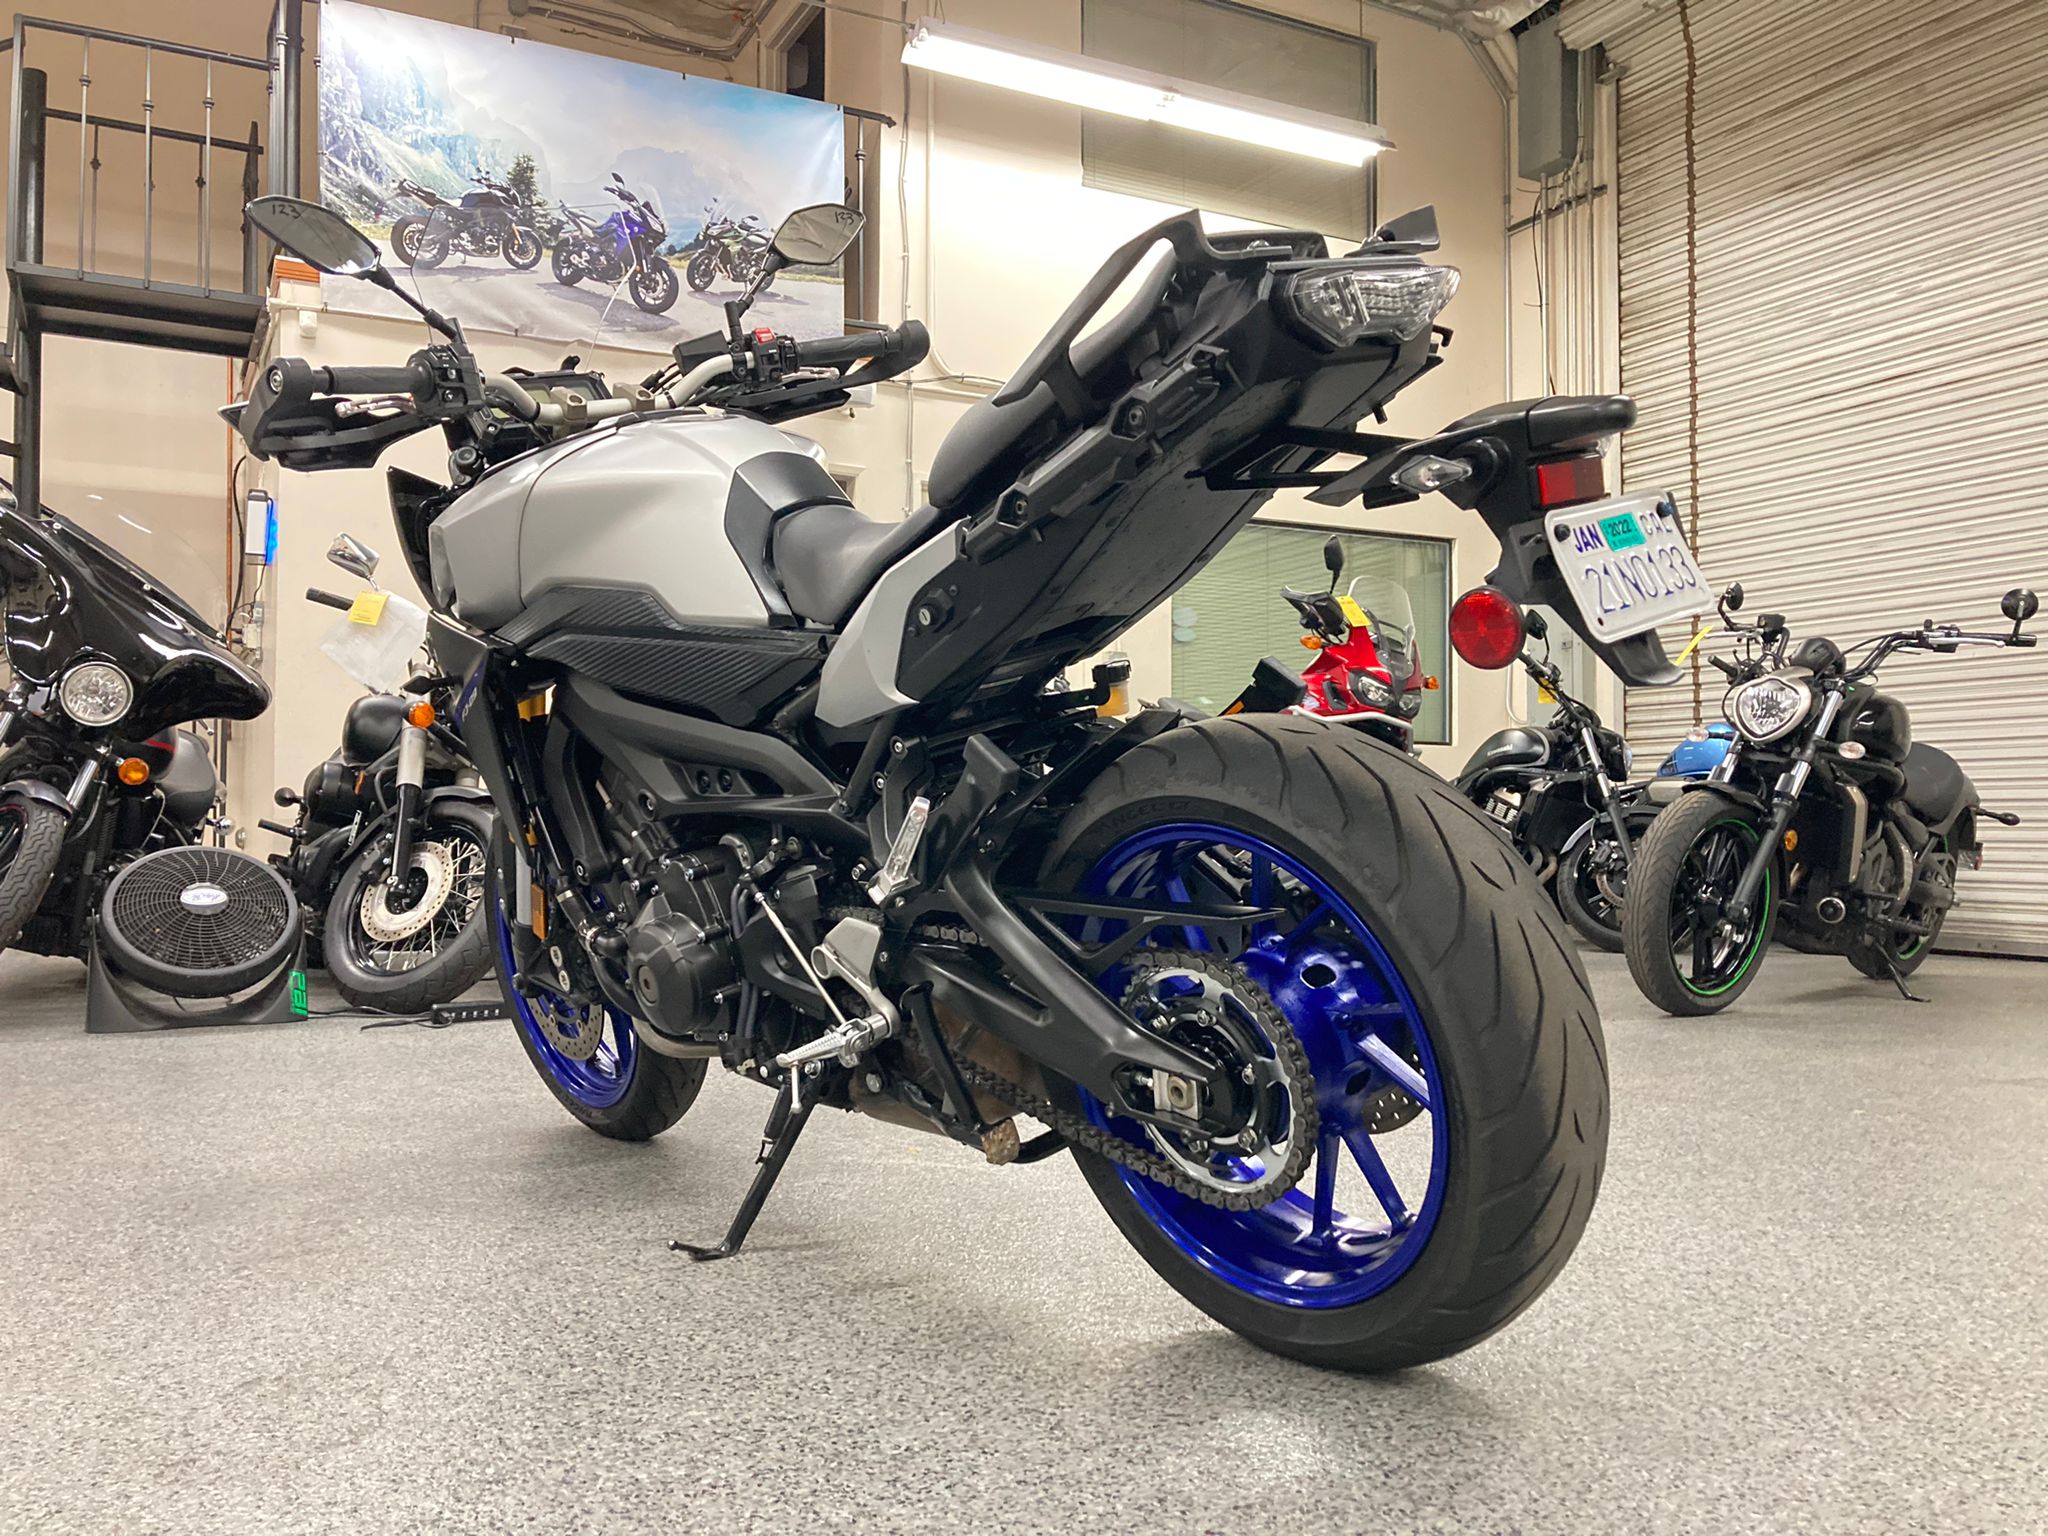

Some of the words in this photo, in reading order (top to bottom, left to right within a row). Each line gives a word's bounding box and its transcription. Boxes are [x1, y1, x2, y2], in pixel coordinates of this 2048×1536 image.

[272, 204, 301, 219] 123
[834, 211, 854, 225] 123
[1572, 523, 1605, 553] JAN
[1608, 518, 1632, 537] 2022
[1585, 546, 1697, 614] 21N0133
